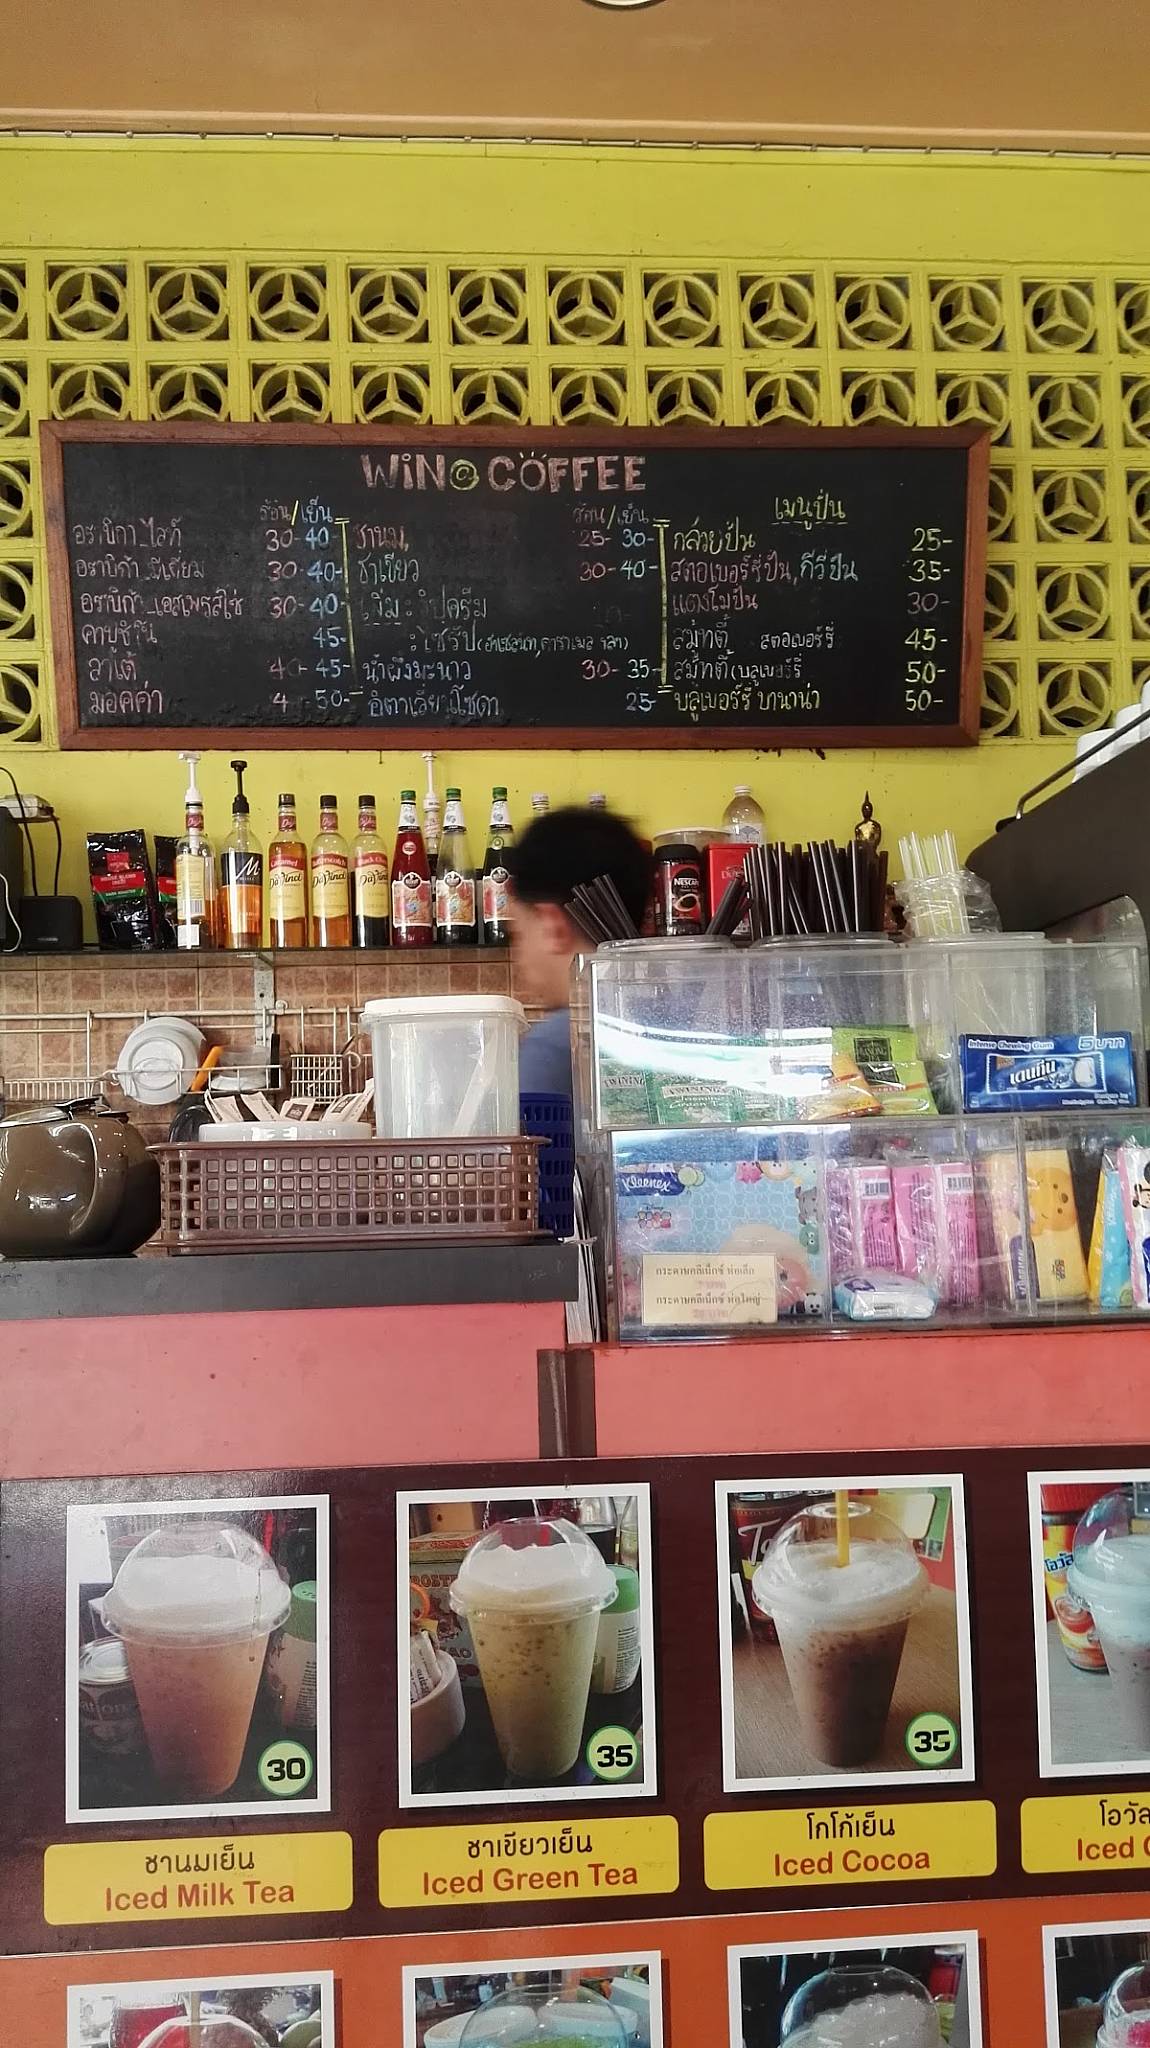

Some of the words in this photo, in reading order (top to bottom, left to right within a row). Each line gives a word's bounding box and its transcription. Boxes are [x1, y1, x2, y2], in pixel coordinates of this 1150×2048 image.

[488, 452, 646, 492] COFFEE
[358, 552, 420, 585] ชาเขียว
[90, 680, 164, 714] มอคค่า
[968, 1039, 997, 1050] Intense
[998, 1040, 1031, 1052] Chewing
[622, 1175, 672, 1192] Kleenex
[597, 1744, 634, 1768] 35
[913, 1730, 951, 1753] 35
[266, 1757, 307, 1782] 30
[806, 1809, 896, 1841] โกโก้เย็น
[144, 1842, 256, 1876] ชานมเย็น
[466, 1825, 594, 1861] ชาเขียวเย็น
[1077, 1835, 1135, 1862] Iced
[422, 1868, 487, 1896] Iced
[491, 1863, 581, 1893] Green
[587, 1860, 639, 1888] Tea
[773, 1850, 834, 1878] Iced
[842, 1847, 931, 1874] Cocoa
[105, 1885, 168, 1912] Iced
[177, 1881, 236, 1909] Milk
[243, 1878, 296, 1906] Tea
